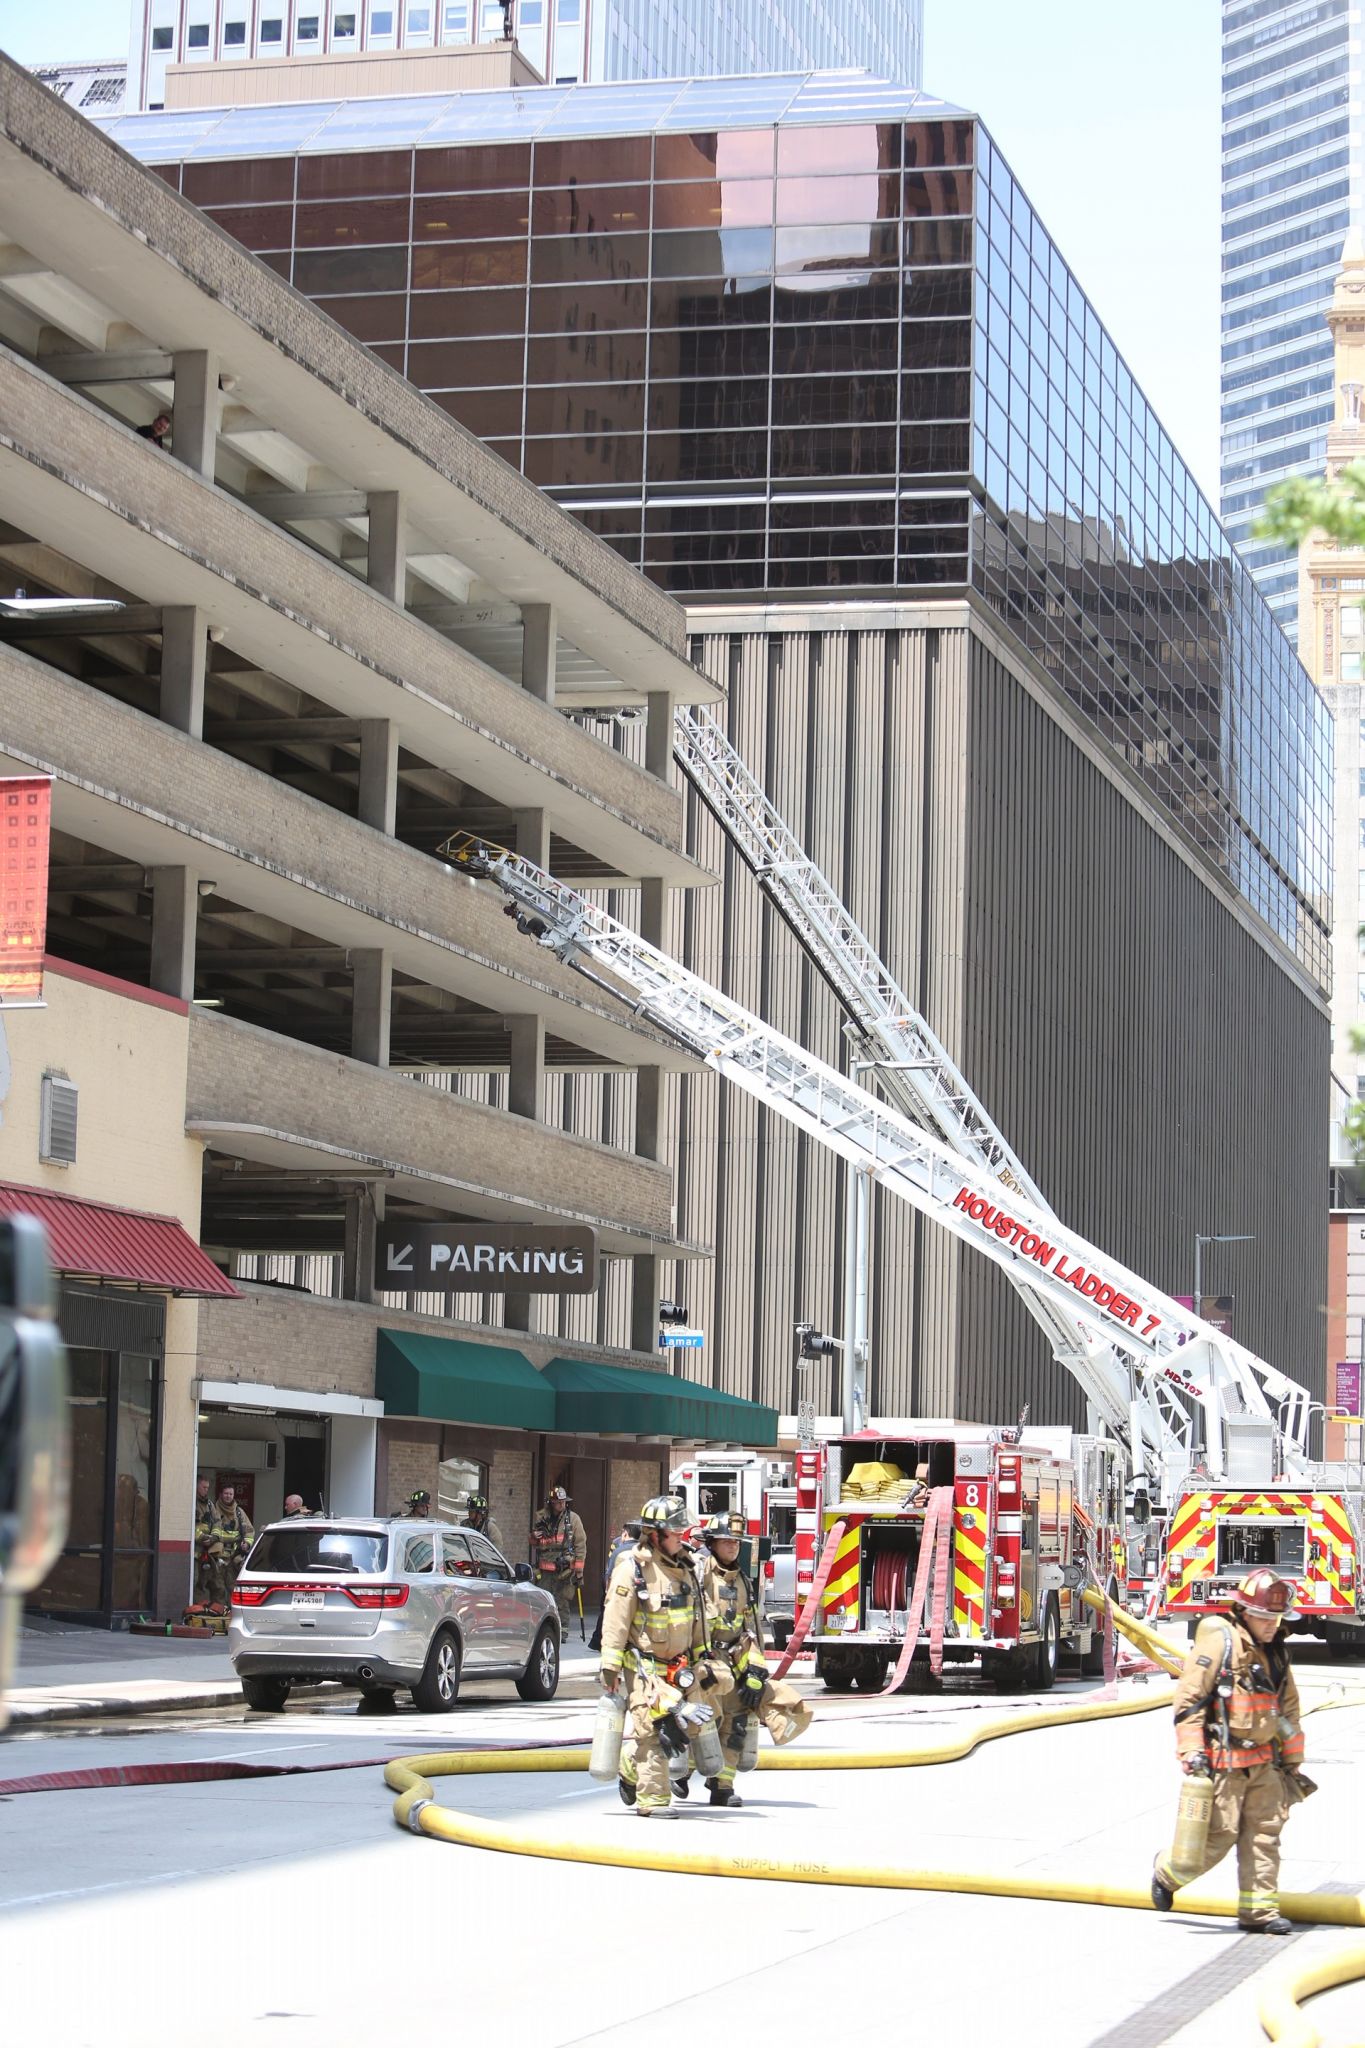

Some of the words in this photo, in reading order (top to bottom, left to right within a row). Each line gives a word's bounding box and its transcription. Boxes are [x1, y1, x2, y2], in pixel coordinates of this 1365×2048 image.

[430, 1244, 584, 1275] PARKING
[953, 1187, 1056, 1267] HOUSTON
[1052, 1255, 1143, 1327] LADDER
[1142, 1314, 1161, 1336] 7
[661, 1336, 697, 1346] Lamar
[1164, 1368, 1203, 1397] HD-107
[966, 1484, 979, 1507] 8
[732, 1857, 781, 1871] SUPPLY
[793, 1861, 830, 1874] HOSE
